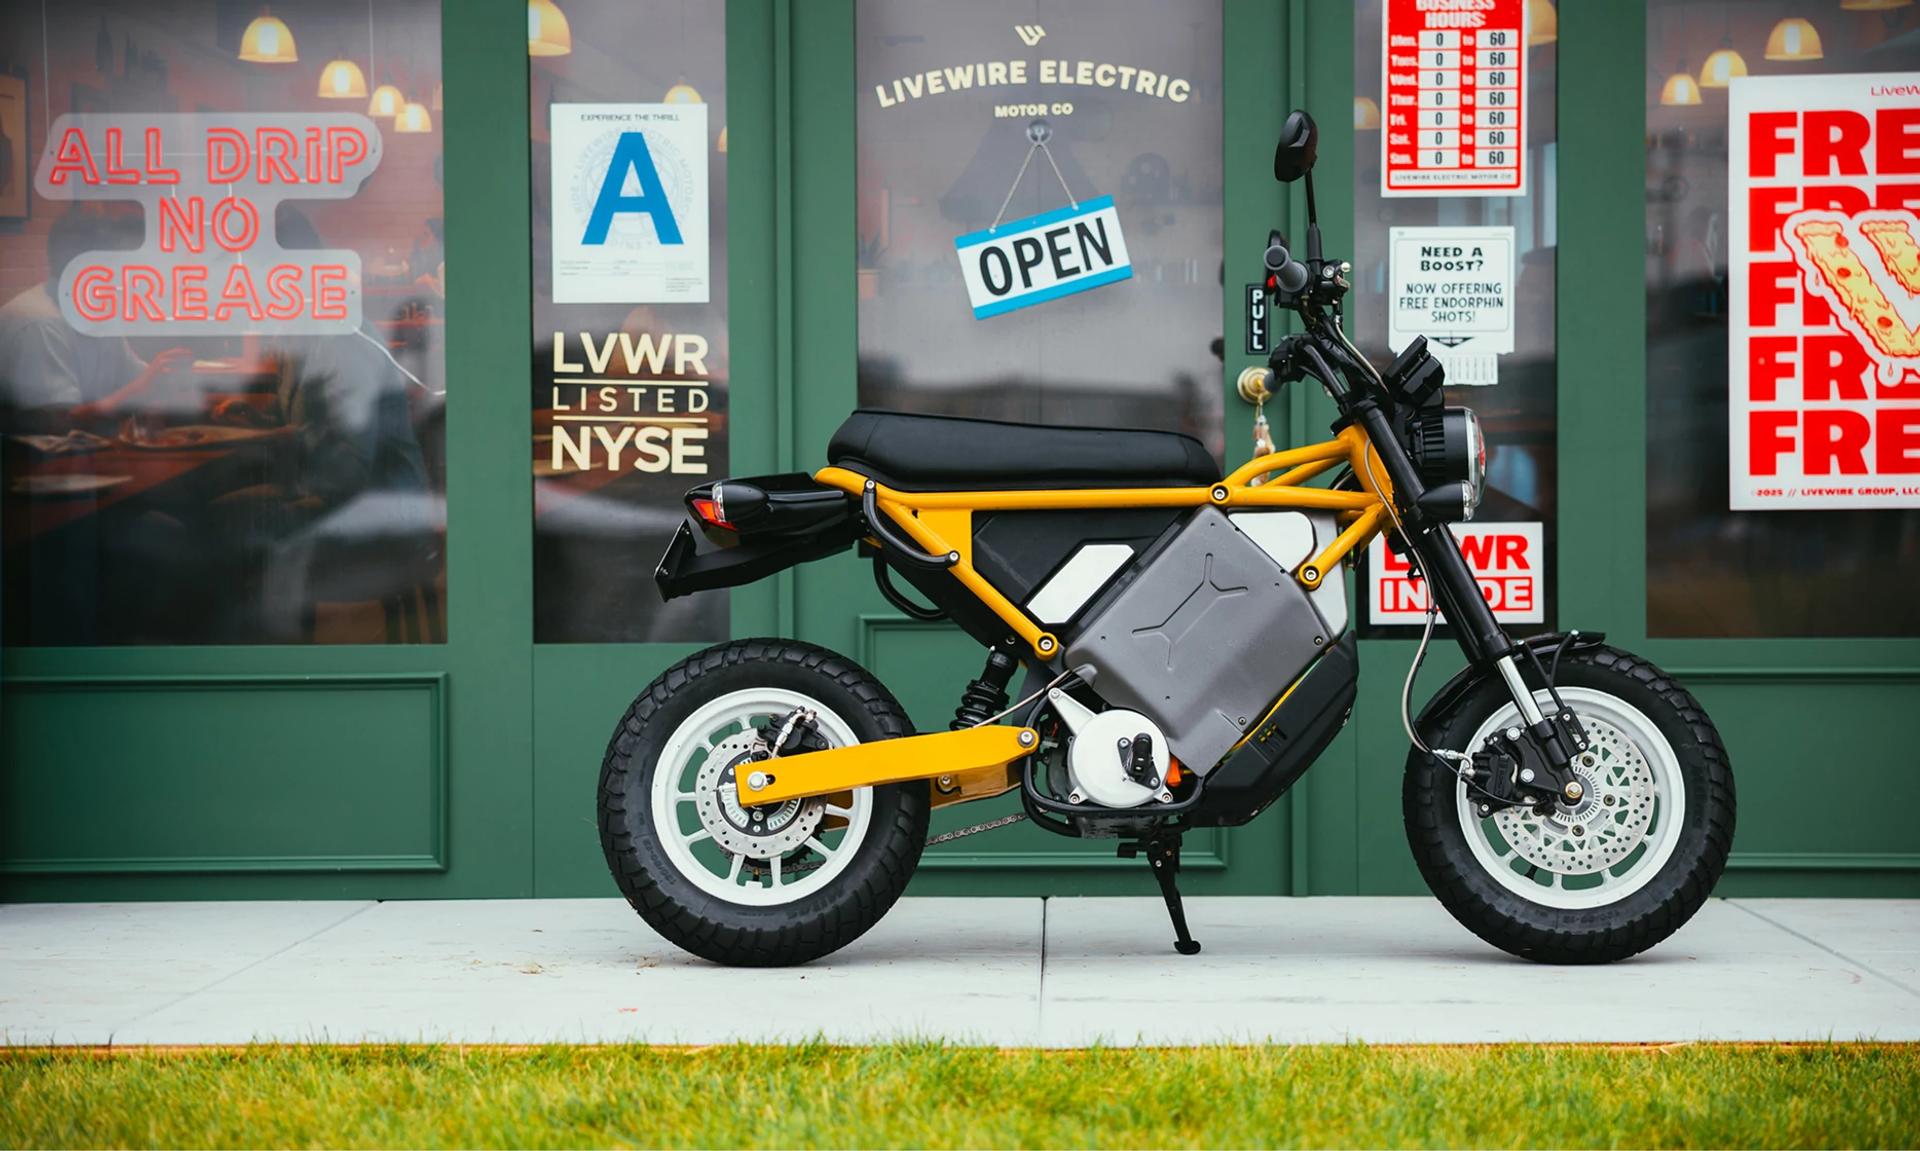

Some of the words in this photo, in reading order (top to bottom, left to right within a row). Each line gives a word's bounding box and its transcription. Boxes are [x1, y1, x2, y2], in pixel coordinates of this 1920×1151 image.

[1416, 0, 1496, 11] BUSINESS
[1436, 32, 1444, 46] 0
[1462, 35, 1474, 46] to
[1490, 32, 1505, 46] 60
[1436, 52, 1443, 66] 0
[1462, 55, 1474, 66] to
[1490, 52, 1505, 66] 60
[875, 60, 1027, 108] LIVEWIRE
[1040, 60, 1191, 103] ELECTRIC
[1436, 72, 1443, 86] 0
[1462, 74, 1474, 86] to
[1489, 71, 1505, 86] 60
[1435, 92, 1443, 106] 0
[1461, 94, 1473, 106] to
[1489, 91, 1505, 105] 60
[580, 113, 631, 121] EXPERIENCE
[634, 113, 649, 121] THE
[652, 113, 680, 121] THRILL
[994, 103, 1048, 118] MOTOR
[1051, 102, 1074, 115] CO
[1435, 112, 1443, 126] 0
[1461, 114, 1473, 126] to
[1489, 111, 1505, 125] 60
[1435, 132, 1443, 146] 0
[1461, 134, 1473, 145] to
[1489, 131, 1504, 145] 60
[1749, 108, 1920, 178] FRE
[49, 127, 180, 186] ALL
[1435, 151, 1443, 165] 0
[1461, 154, 1473, 165] to
[1489, 151, 1504, 165] 60
[581, 132, 684, 245] A
[159, 195, 260, 253] NO
[979, 217, 1114, 296] OPEN
[1421, 246, 1463, 257] NEED
[1472, 247, 1483, 257] A
[1420, 260, 1484, 272] BOOST?
[72, 264, 348, 322] GREASE
[1406, 283, 1437, 295] NOW
[1441, 283, 1502, 295] OFFERING
[1400, 297, 1428, 309] FREE
[1434, 297, 1504, 308] ENDORPHIN
[1252, 289, 1264, 350] PULL
[1431, 311, 1476, 322] SHOTS!
[553, 332, 709, 375] LVWR
[553, 386, 709, 413] LISTED
[552, 425, 709, 474] NYSE
[1749, 408, 1920, 476] FRE
[1801, 488, 1854, 497] LIVEWIRE
[1857, 488, 1899, 497] GROUP,
